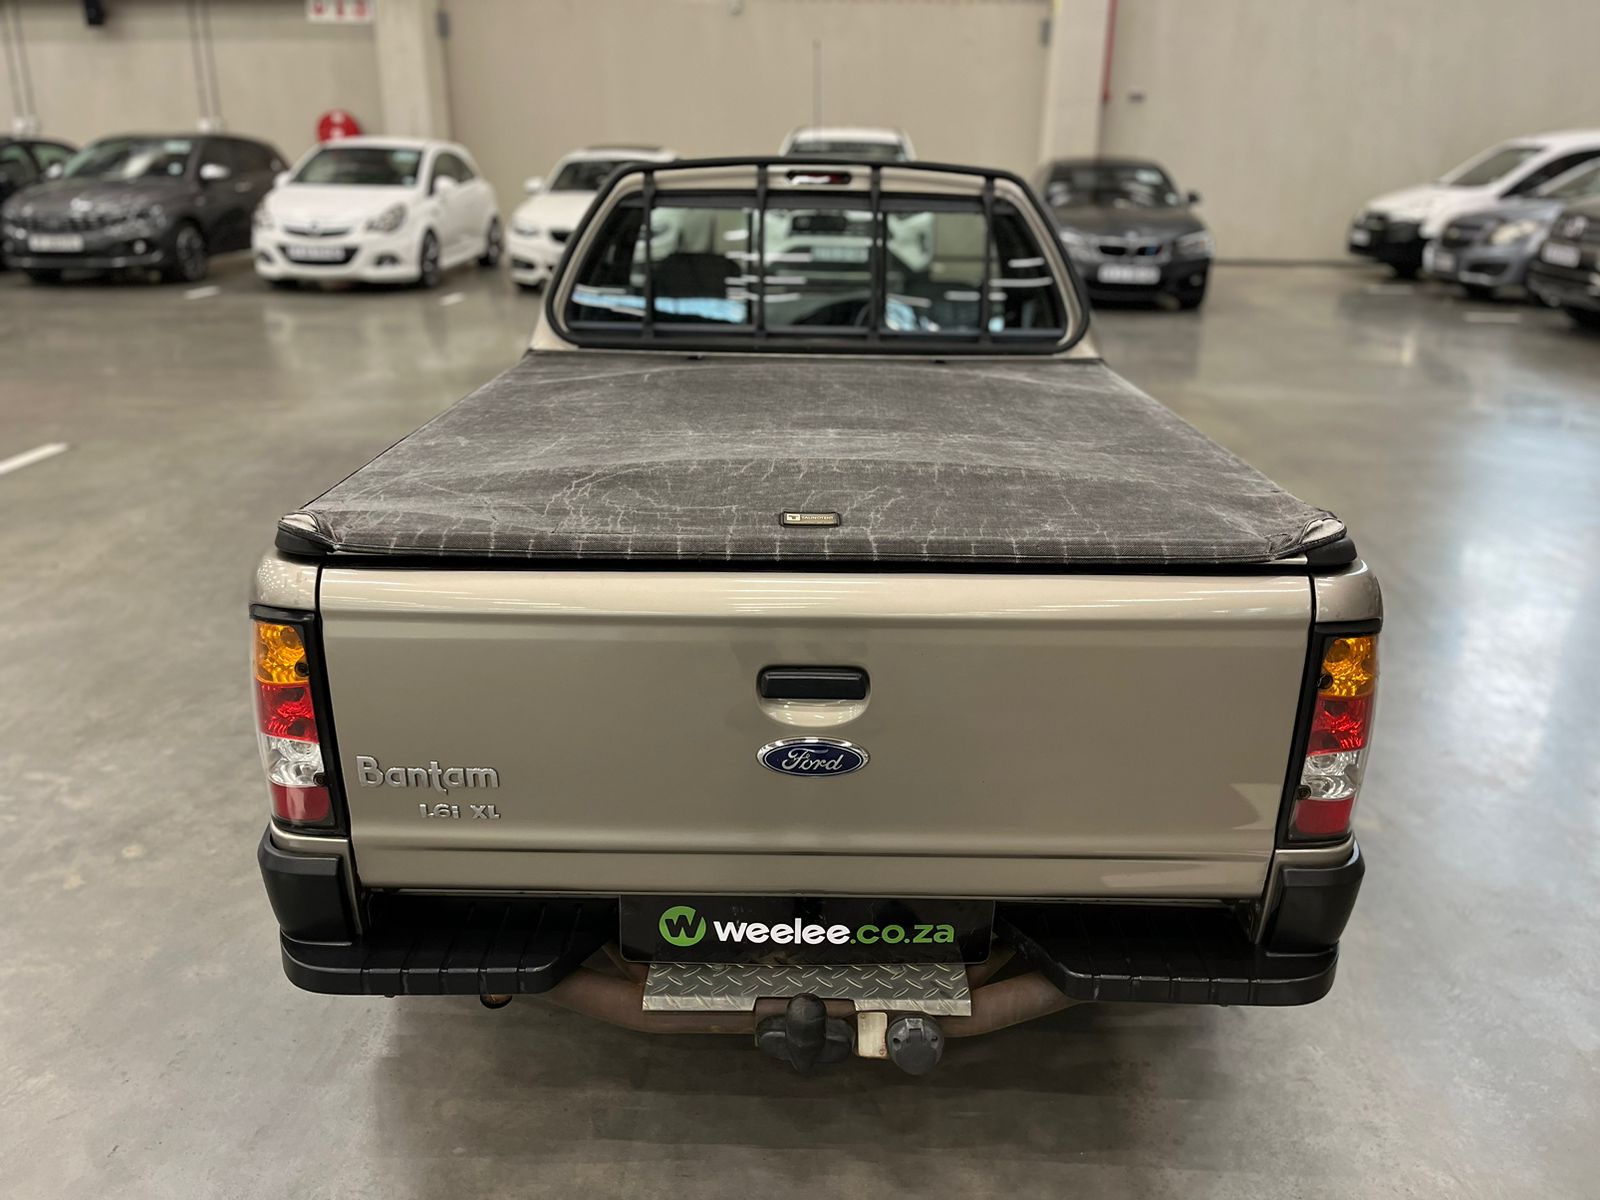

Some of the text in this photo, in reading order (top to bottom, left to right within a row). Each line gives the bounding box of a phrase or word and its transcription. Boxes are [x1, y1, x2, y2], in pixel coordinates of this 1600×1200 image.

[781, 747, 845, 770] Ford
[356, 755, 499, 794] Bantam
[469, 804, 501, 819] XL
[713, 917, 955, 945] weelee.co.za
